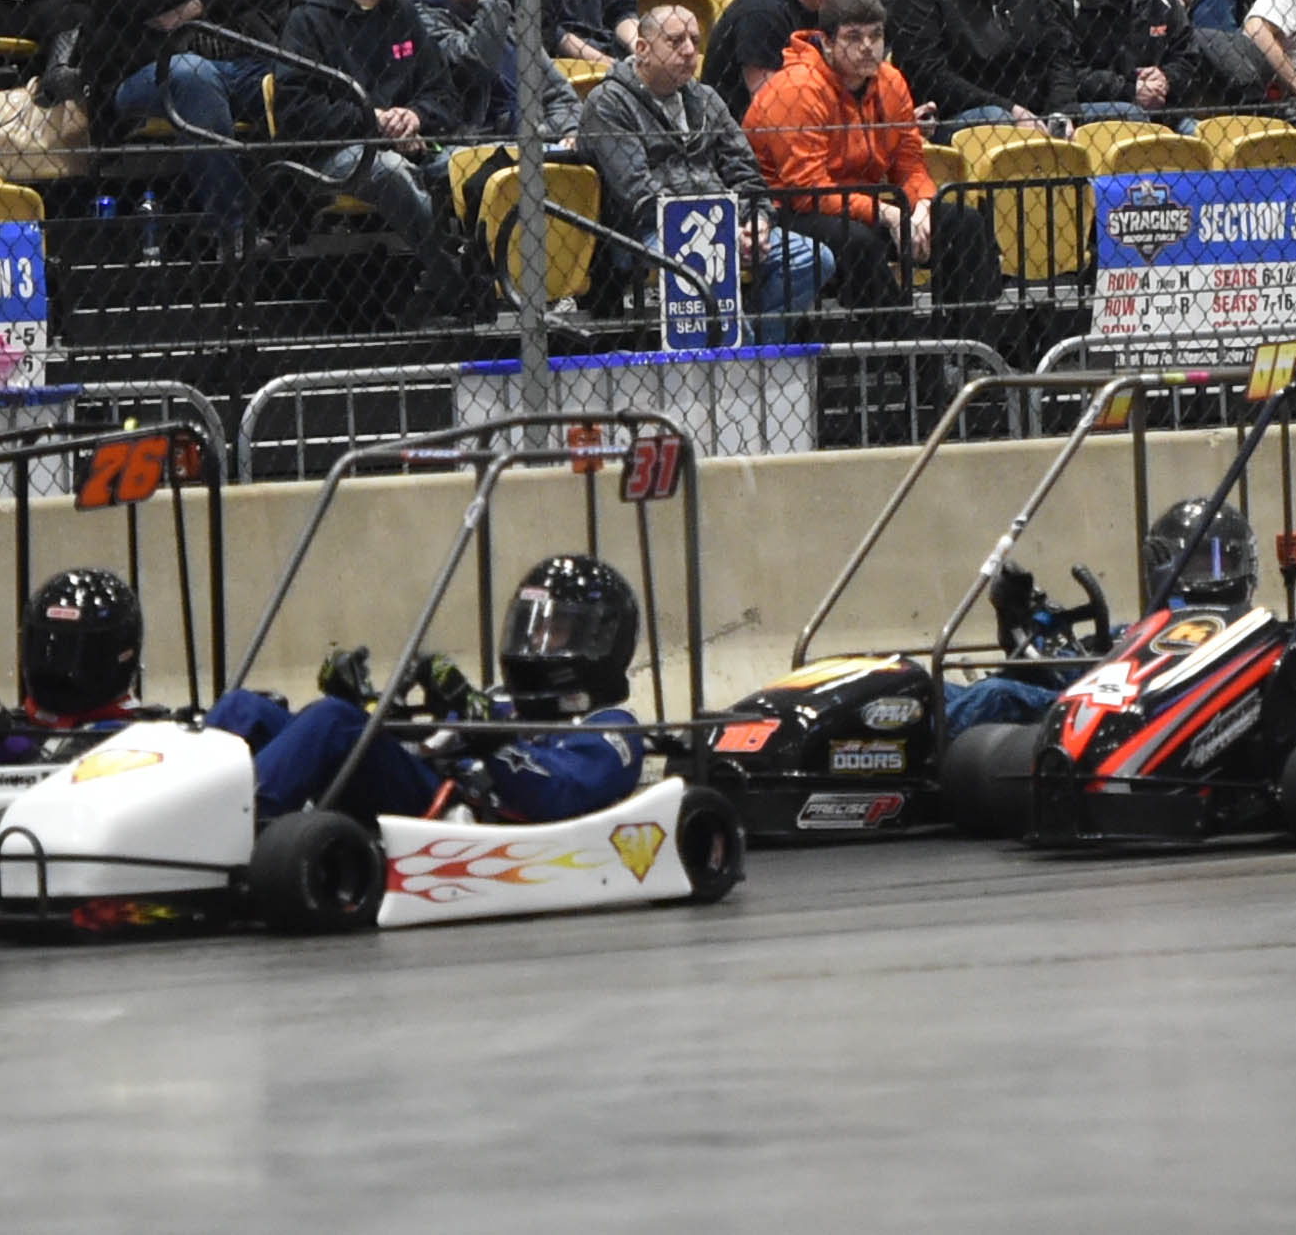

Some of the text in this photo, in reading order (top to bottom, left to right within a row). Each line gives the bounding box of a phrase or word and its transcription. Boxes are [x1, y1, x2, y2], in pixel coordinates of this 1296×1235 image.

[1108, 210, 1191, 235] SYRACUSE
[1199, 202, 1286, 242] SECTION
[17, 257, 34, 298] 3
[1107, 272, 1138, 292] ROW
[1141, 272, 1151, 291] A
[1213, 269, 1257, 287] SEATS
[669, 298, 735, 315] RESEED
[1104, 297, 1136, 317] ROW
[1141, 297, 1150, 316] J
[1212, 294, 1258, 314] SEATS
[1262, 292, 1294, 312] 7-16
[624, 436, 682, 500] 31
[833, 751, 903, 771] DOORS
[806, 802, 869, 814] PRECISE
